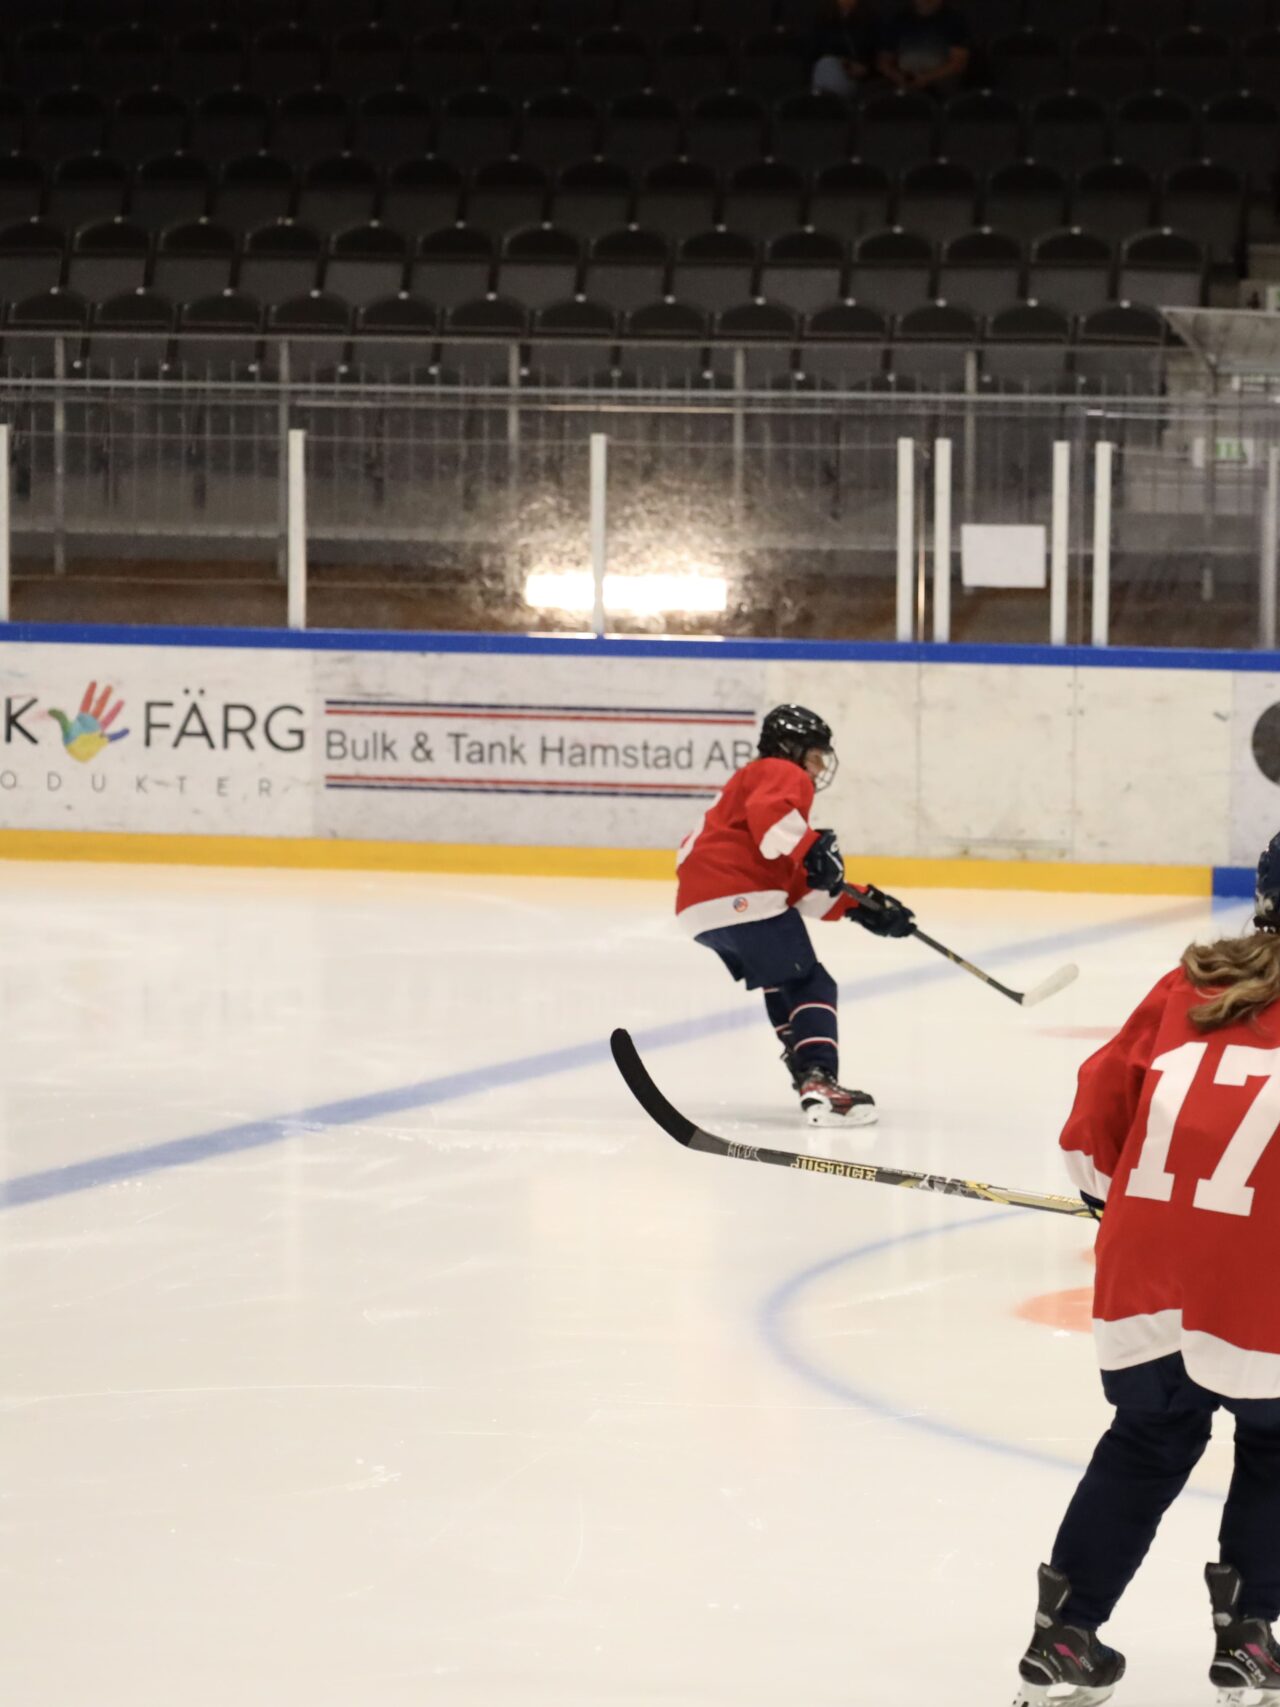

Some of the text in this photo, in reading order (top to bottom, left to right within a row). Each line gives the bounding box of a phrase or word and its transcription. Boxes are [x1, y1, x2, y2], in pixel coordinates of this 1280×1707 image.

[4, 688, 306, 752] K FÄRG
[325, 729, 758, 770] Bulk & Tank Hamstad AB
[790, 1155, 878, 1182] JUSTICE
[1234, 1649, 1266, 1683] CCM
